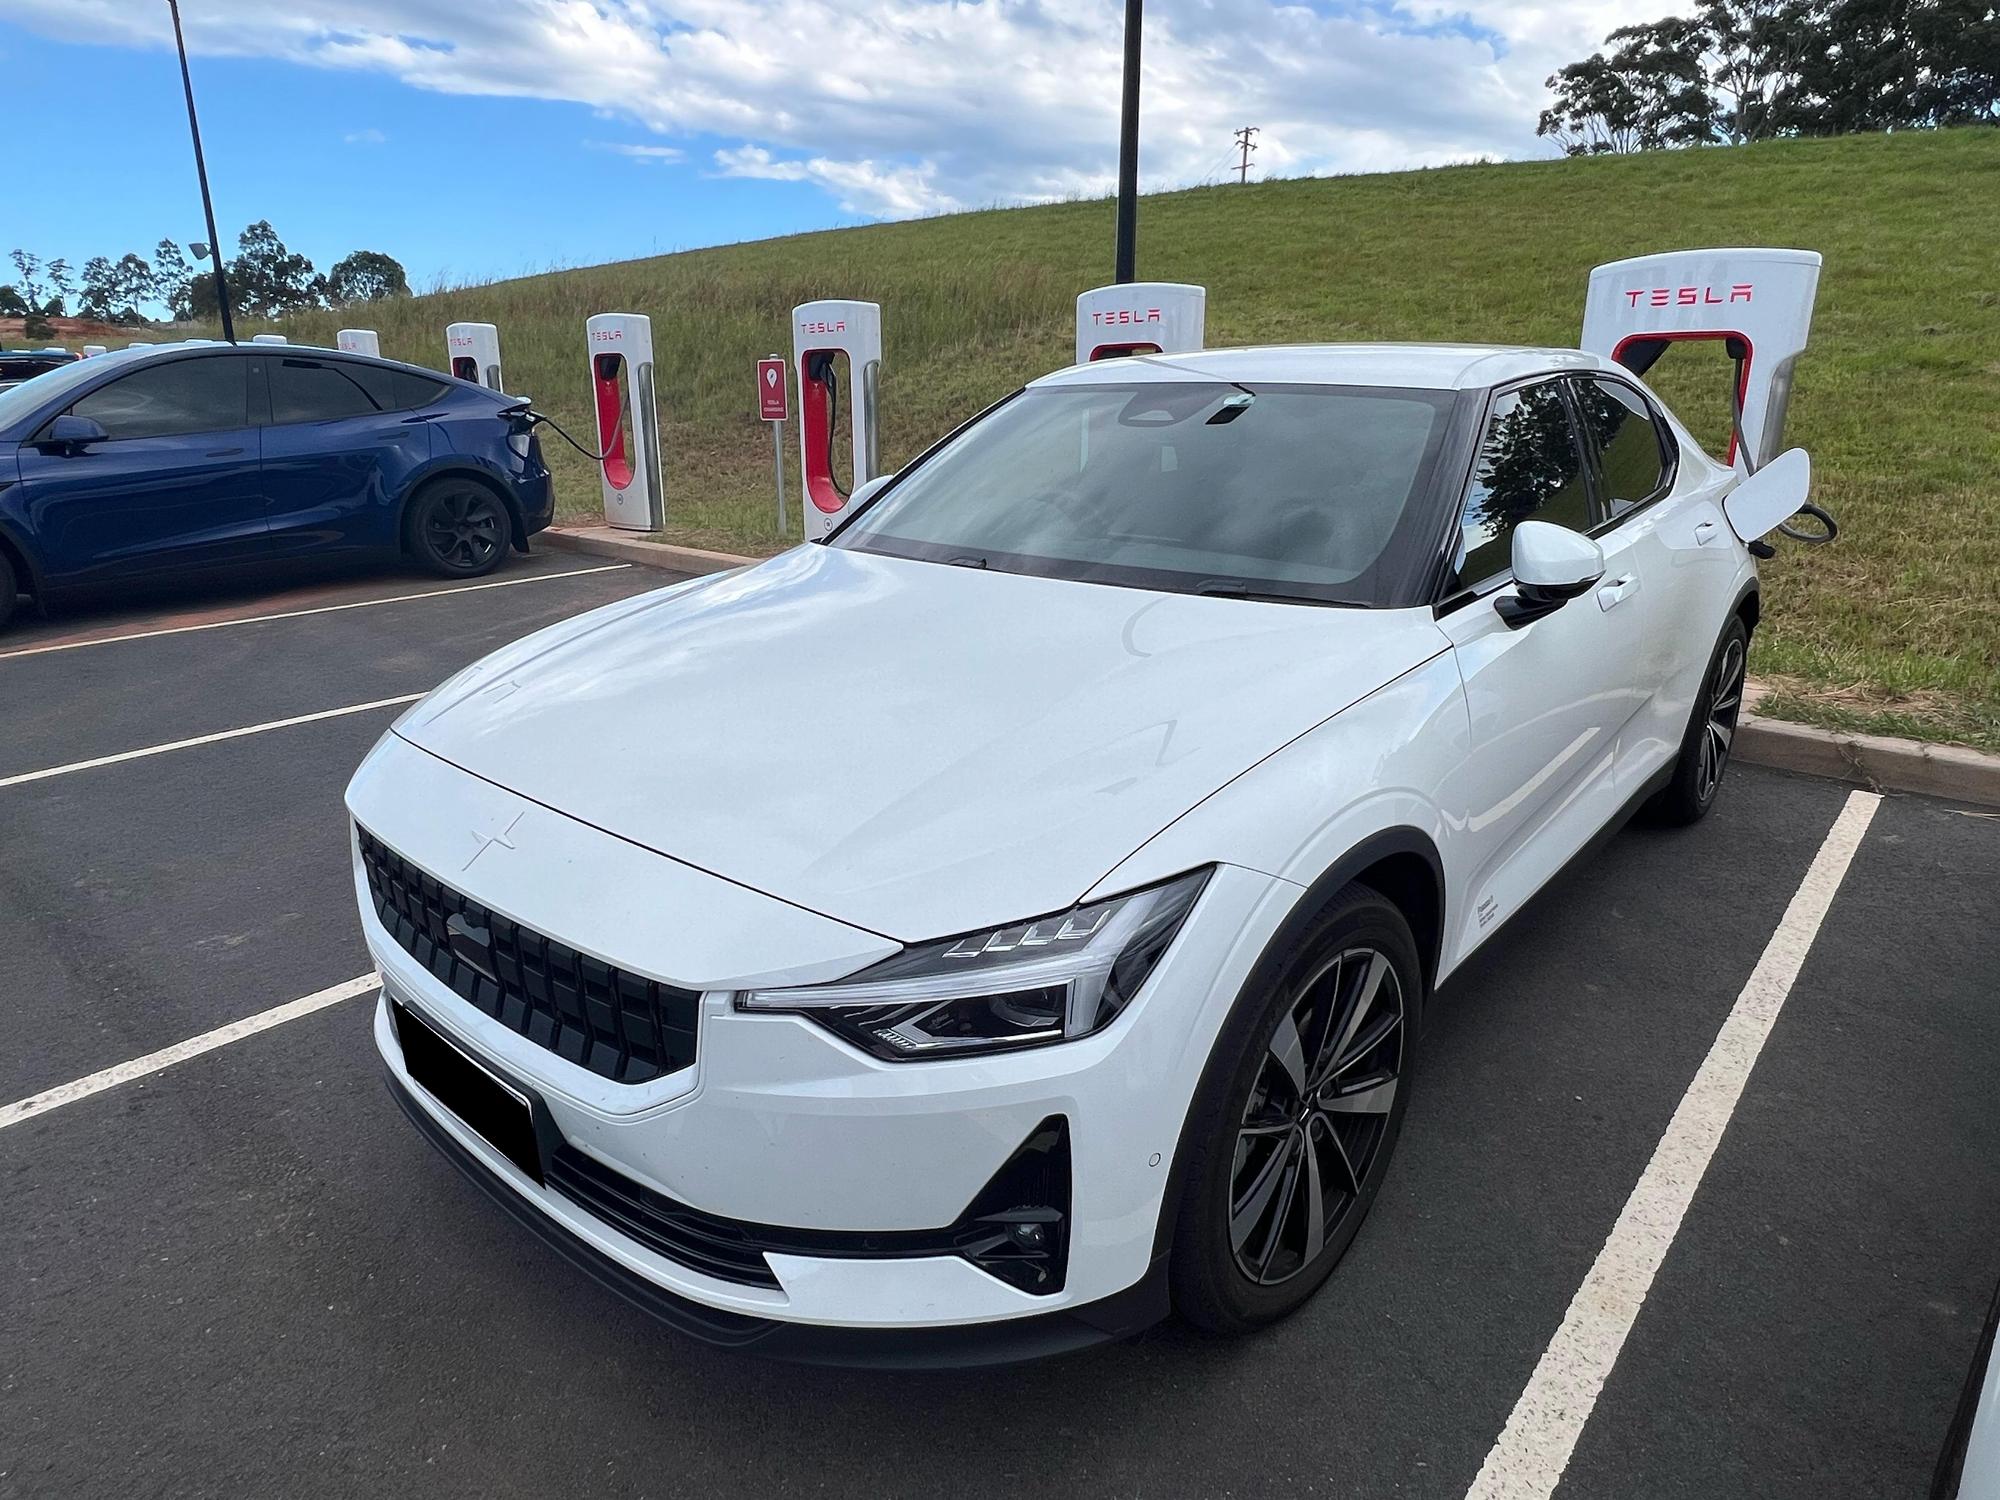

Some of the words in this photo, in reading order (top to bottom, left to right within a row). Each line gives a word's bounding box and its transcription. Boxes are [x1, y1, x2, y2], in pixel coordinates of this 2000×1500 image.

[1625, 284, 1753, 308] TESLA
[1092, 309, 1160, 325] TESLA
[801, 321, 845, 334] TESLA
[591, 330, 622, 341] TESLA
